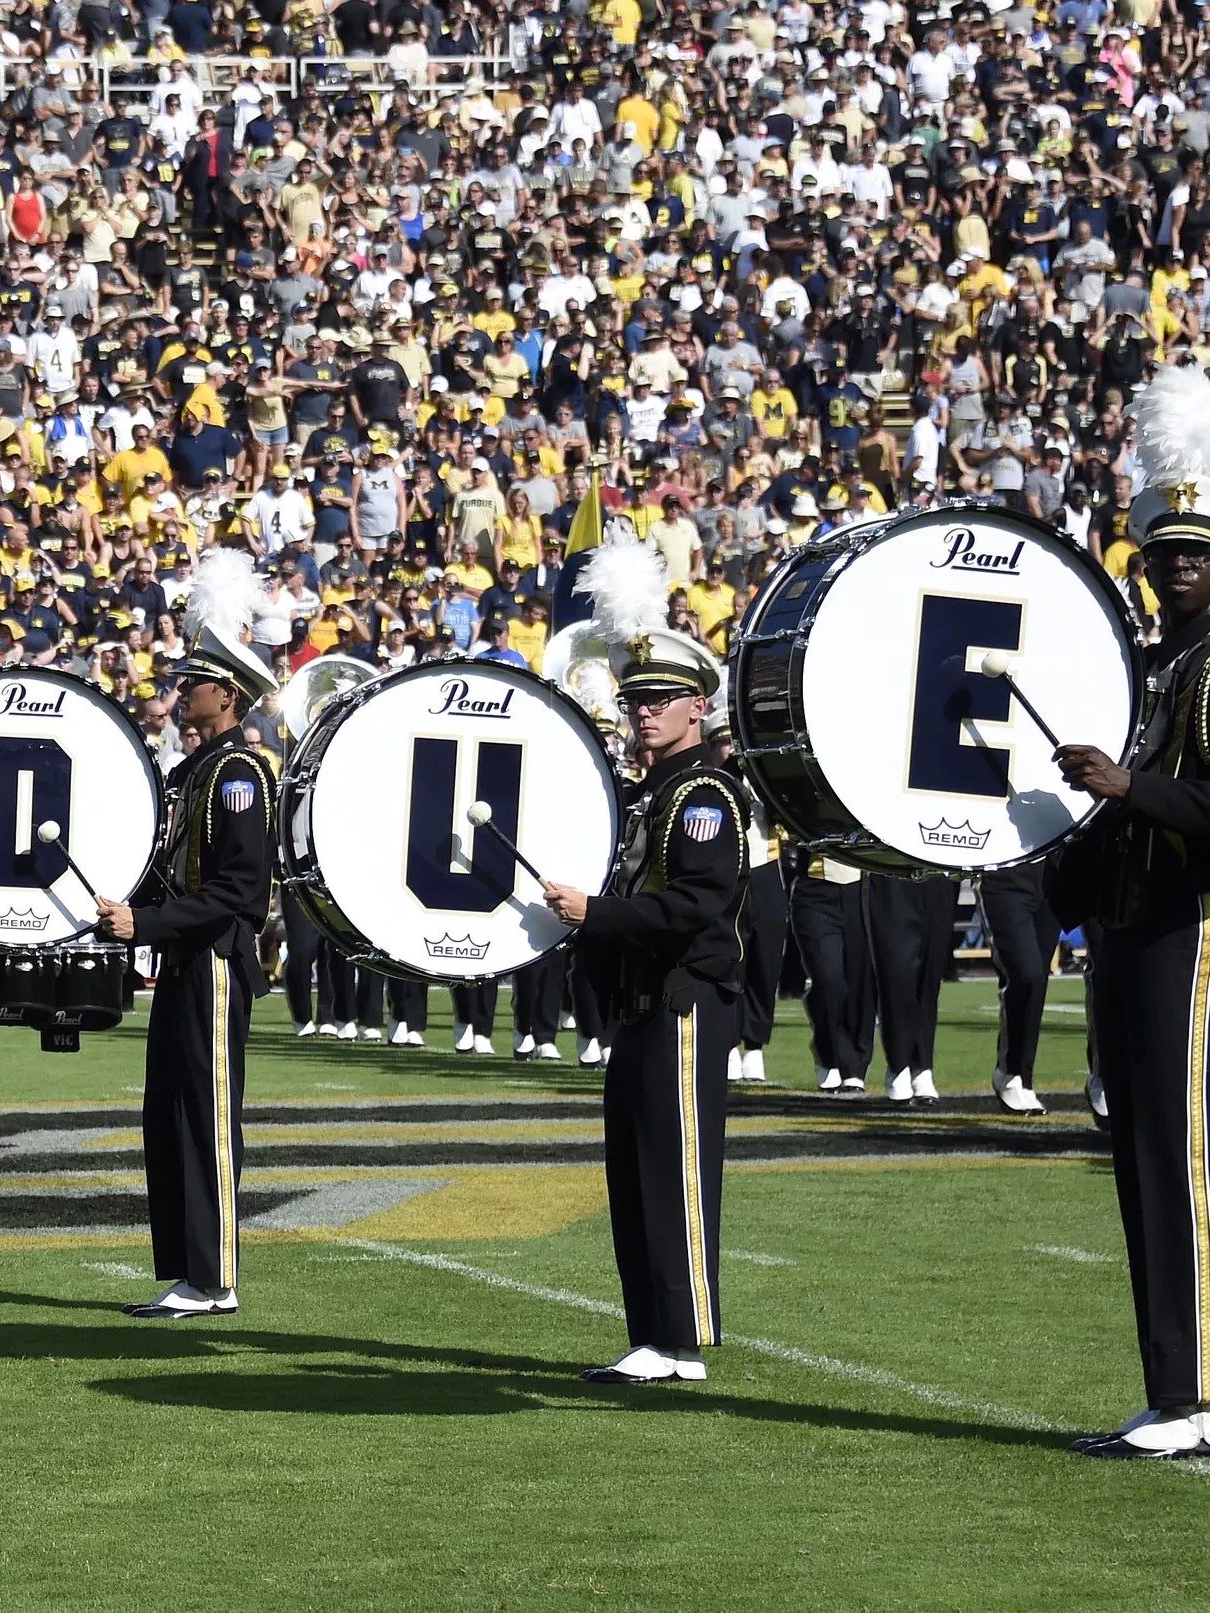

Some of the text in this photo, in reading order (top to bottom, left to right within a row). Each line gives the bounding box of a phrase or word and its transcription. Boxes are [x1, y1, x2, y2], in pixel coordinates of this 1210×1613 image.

[50, 348, 63, 373] 4
[369, 479, 390, 490] M
[270, 510, 282, 534] 4
[930, 528, 1025, 575] Pearl
[428, 679, 515, 719] Pearl
[905, 591, 1026, 800] E
[403, 734, 526, 916] U
[928, 832, 980, 846] REMO
[0, 918, 42, 929] REMO
[433, 945, 481, 957] REMO
[52, 1010, 83, 1025] Pearl
[53, 1035, 74, 1046] VIC
